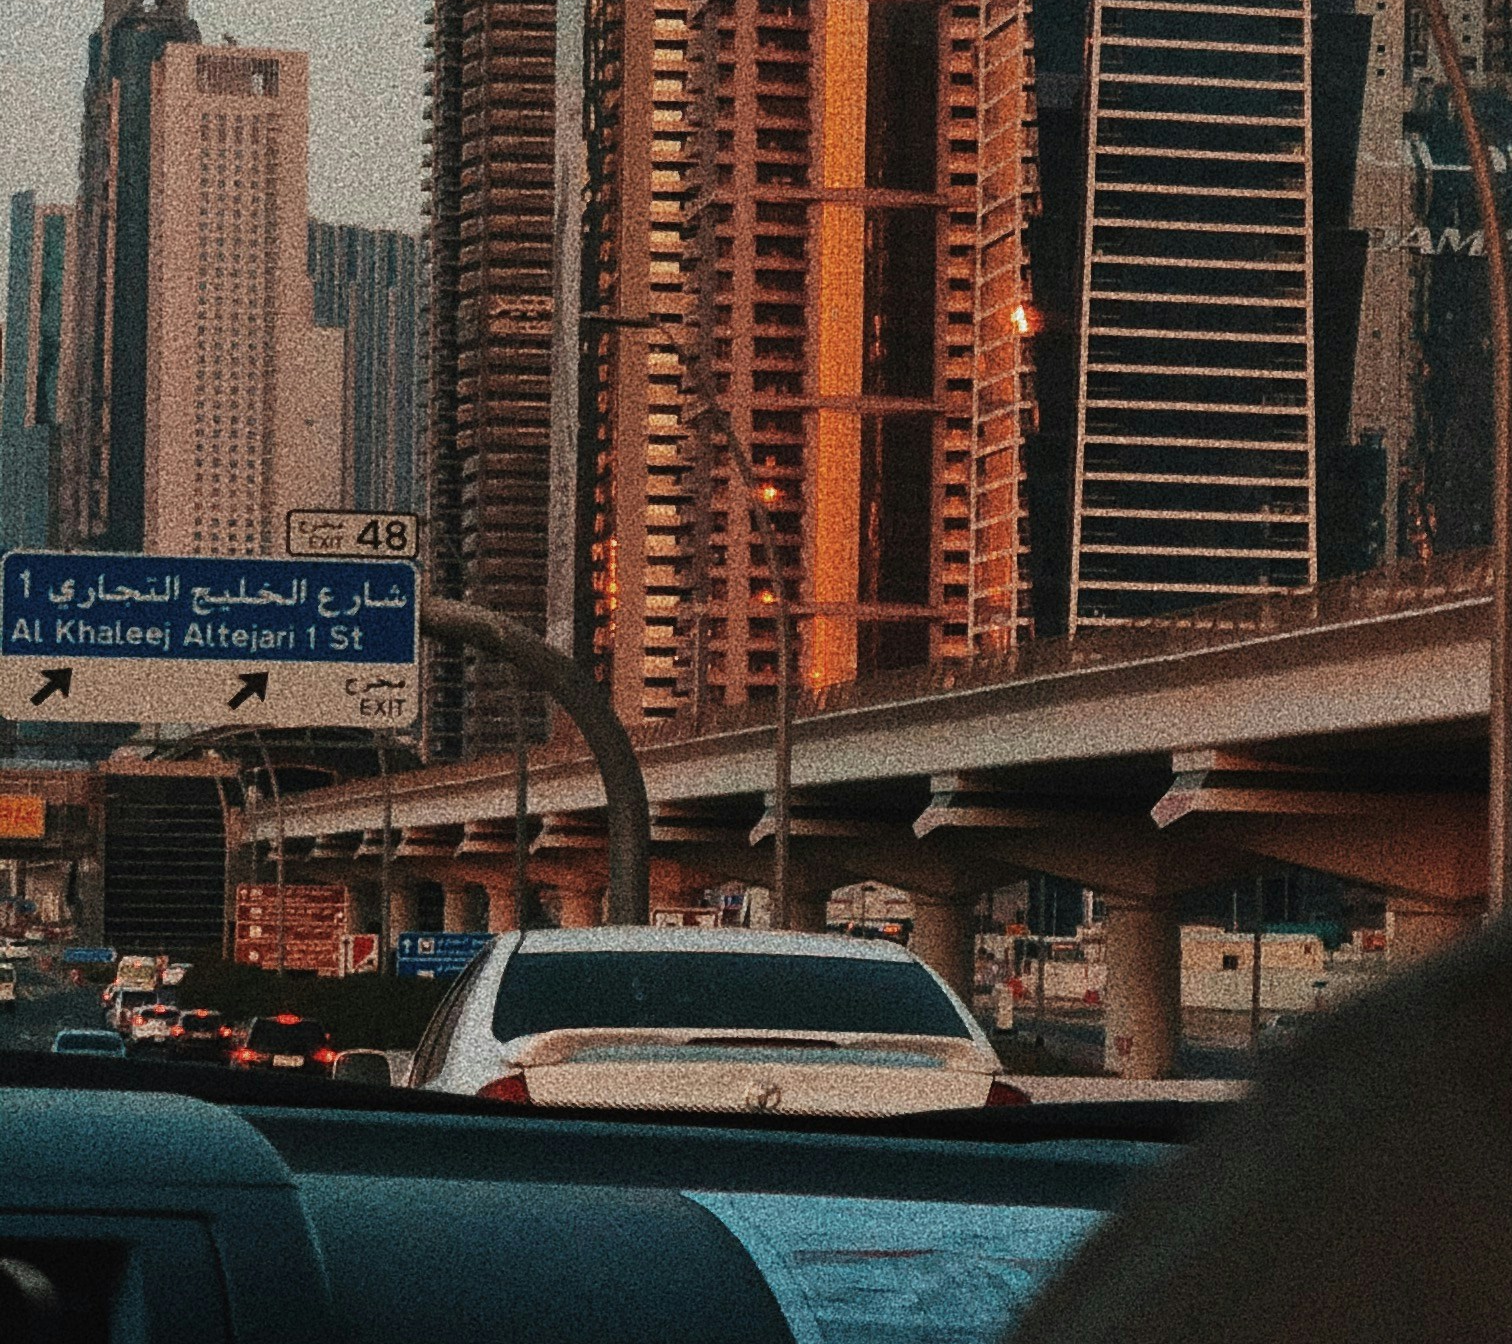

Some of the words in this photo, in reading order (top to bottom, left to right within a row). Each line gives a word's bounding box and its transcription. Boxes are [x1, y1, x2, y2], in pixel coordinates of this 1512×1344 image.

[308, 535, 345, 551] EXIT
[356, 519, 408, 551] 48
[48, 573, 181, 610] التجاري
[191, 576, 307, 616] الخليج
[317, 579, 408, 619] شارع
[11, 618, 43, 644] Al
[56, 619, 172, 652] Khaleej
[183, 622, 295, 654] Altejari
[306, 625, 316, 651] 1
[330, 625, 364, 652] St
[359, 689, 406, 718] EXIT
